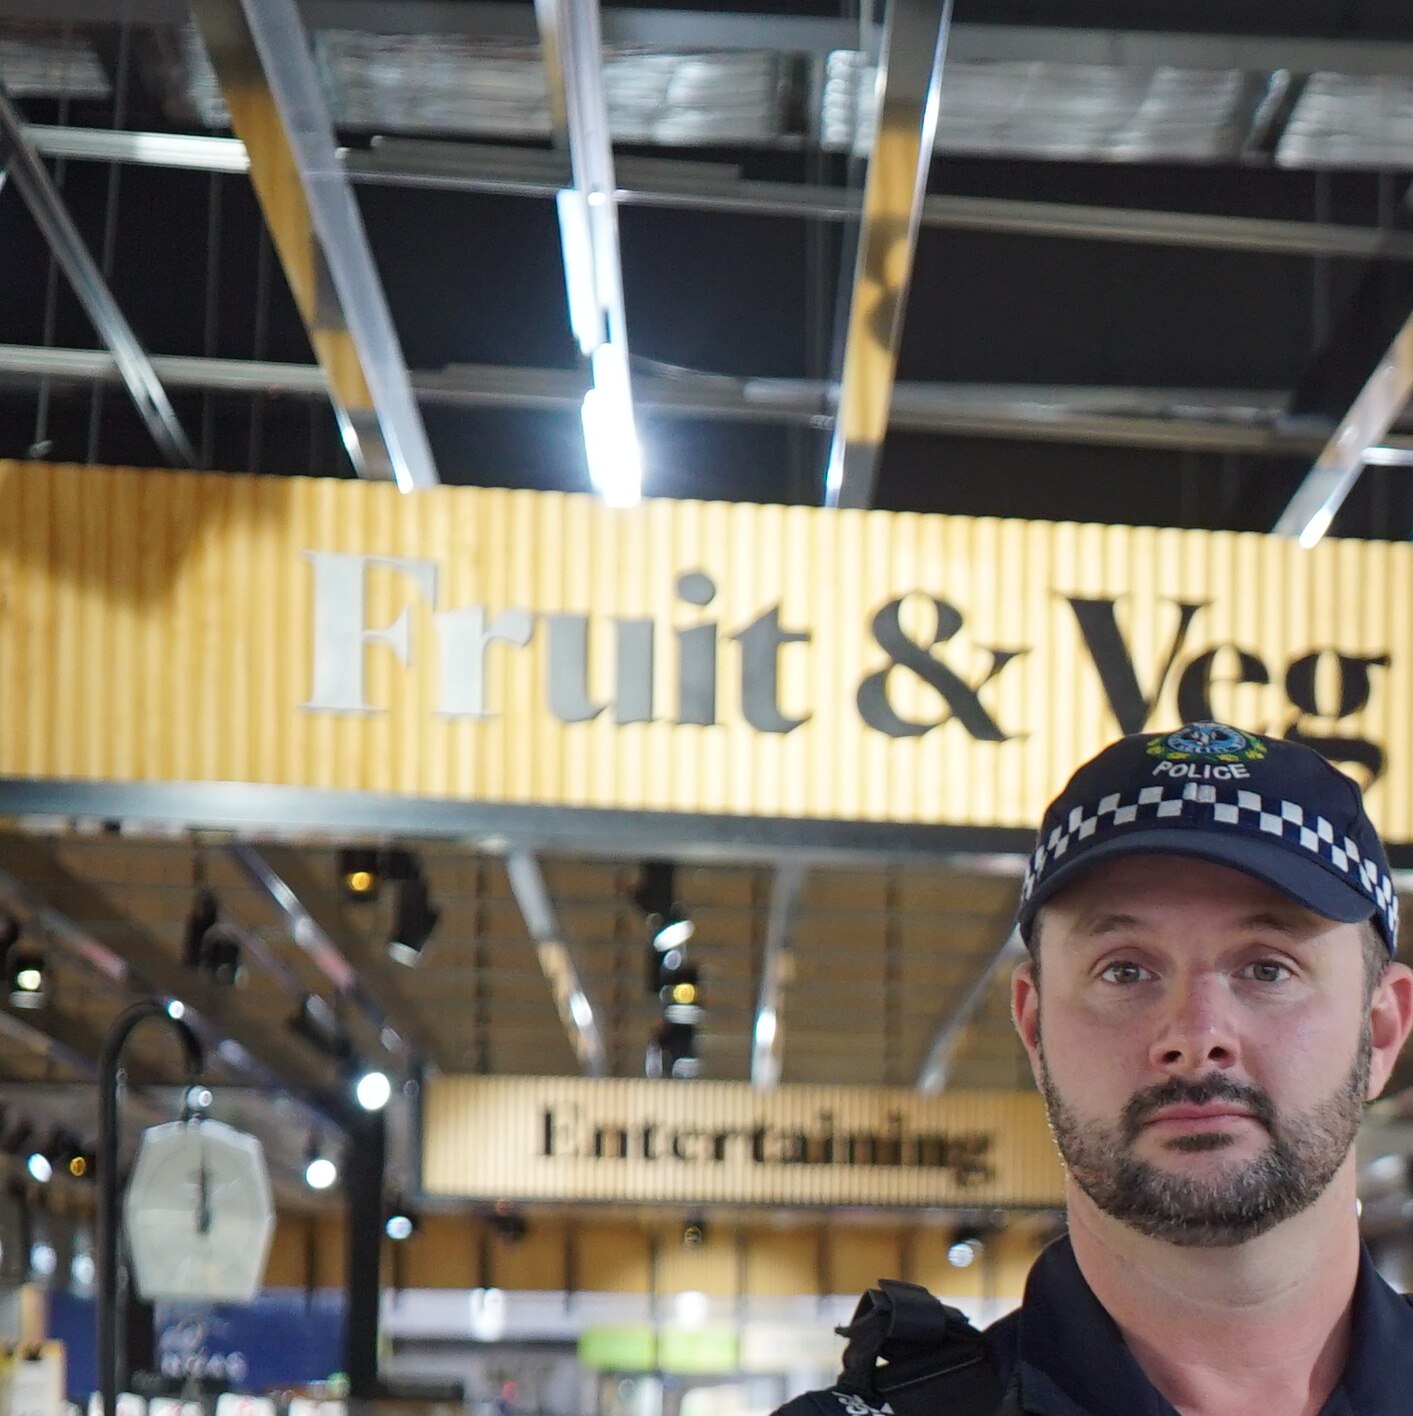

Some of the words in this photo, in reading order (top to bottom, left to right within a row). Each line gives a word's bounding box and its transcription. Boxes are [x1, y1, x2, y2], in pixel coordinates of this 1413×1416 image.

[300, 548, 814, 734] Fruit
[856, 590, 1031, 741] &
[1055, 592, 1391, 791] Veg
[1152, 760, 1250, 780] POLICE
[536, 1101, 996, 1186] Entertaining
